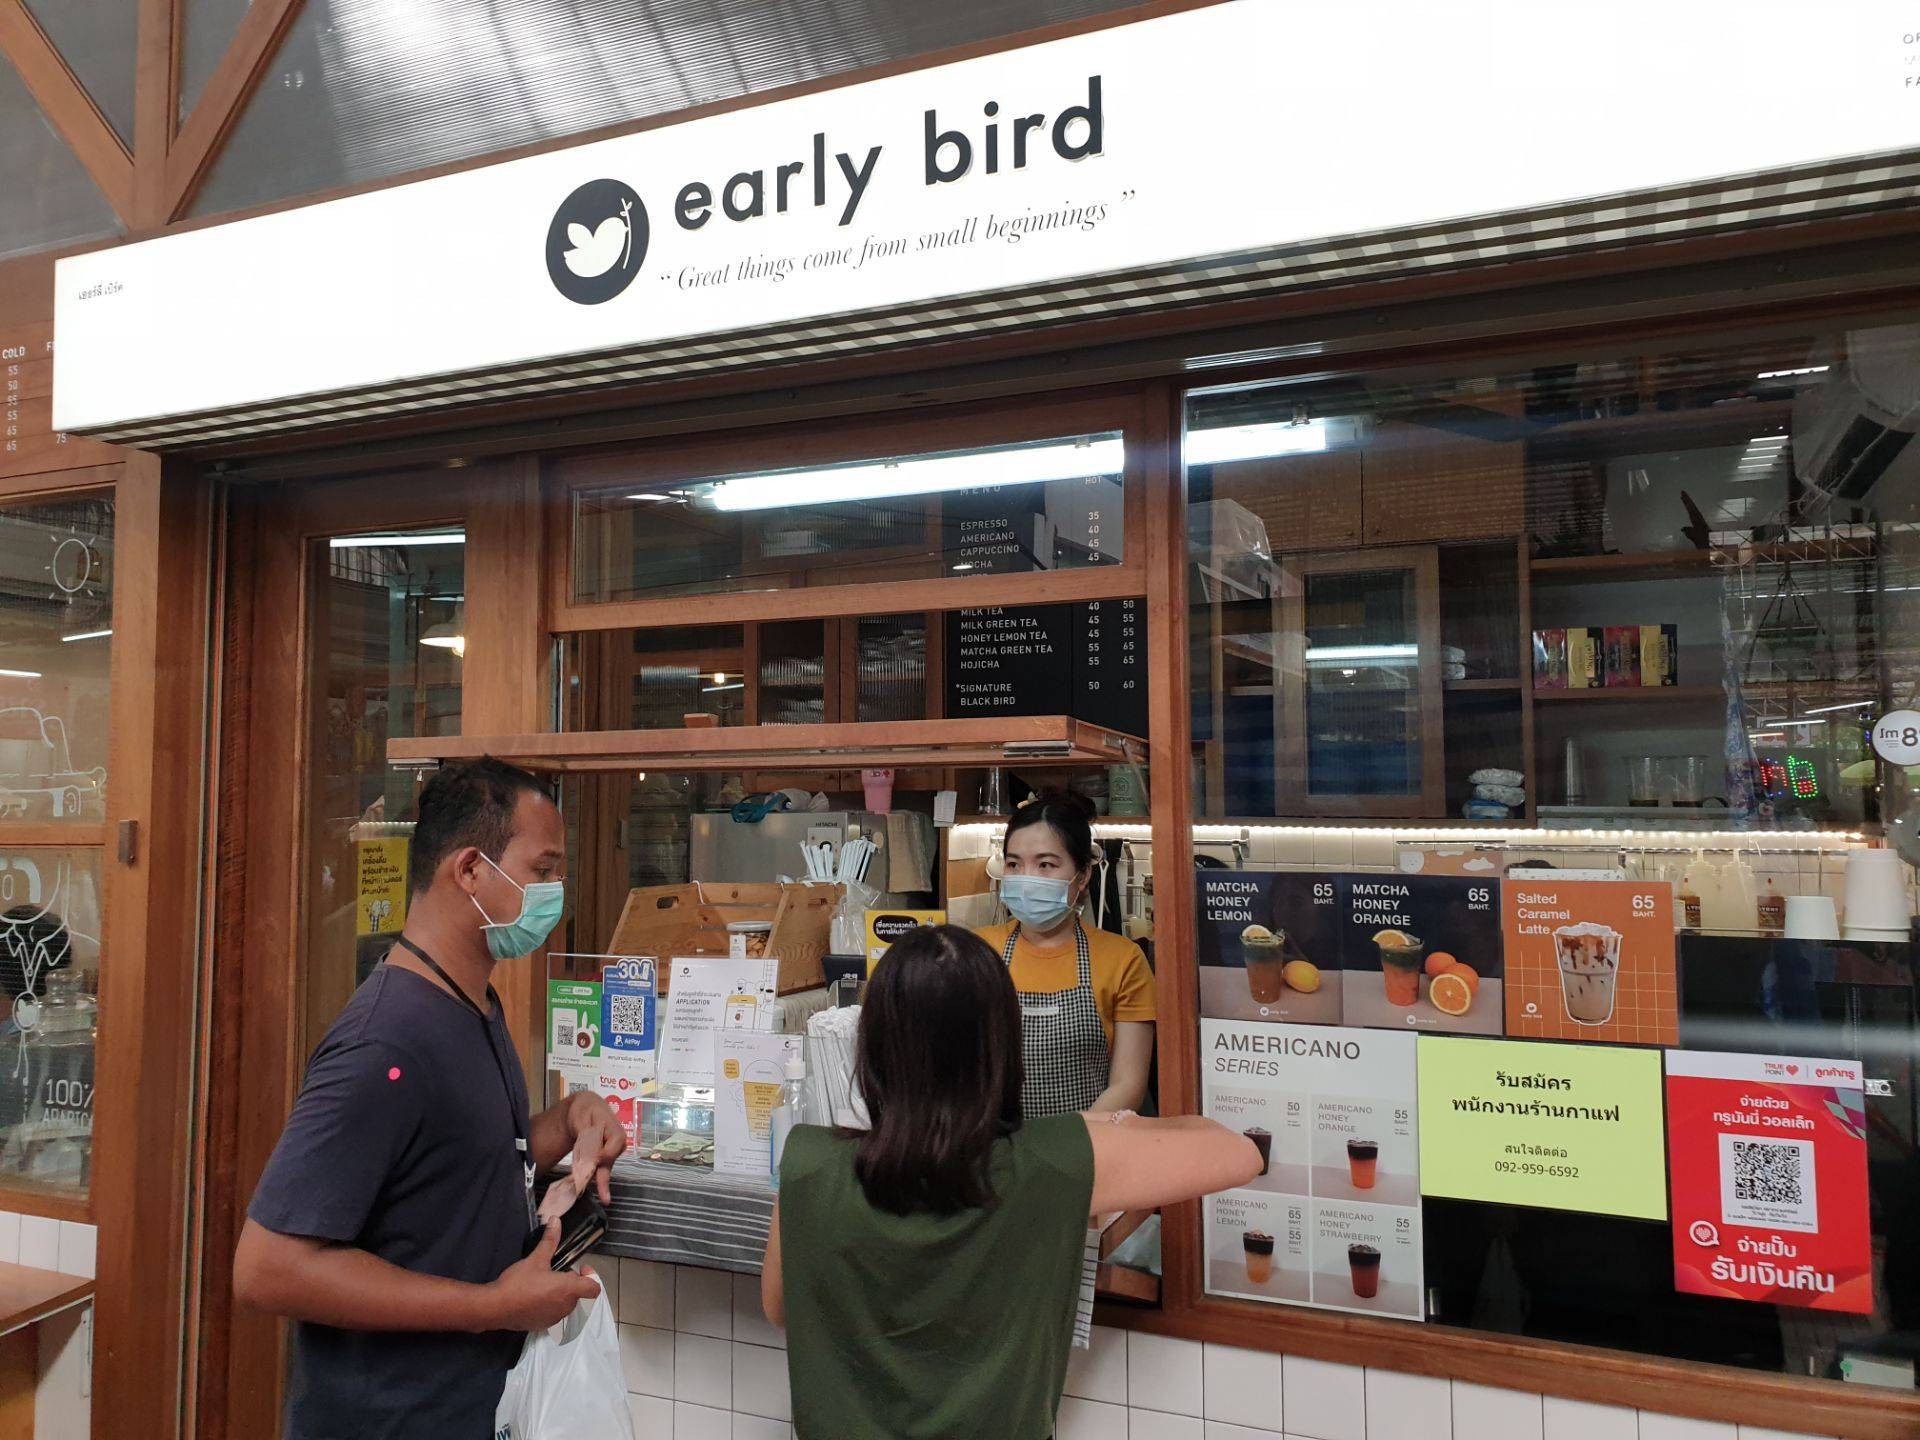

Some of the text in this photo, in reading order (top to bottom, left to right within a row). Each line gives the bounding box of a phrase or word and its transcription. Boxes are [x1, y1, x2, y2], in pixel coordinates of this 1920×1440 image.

[675, 75, 1103, 230] early bird
[738, 254, 796, 283] things
[803, 247, 853, 271] come
[852, 235, 907, 270] from
[916, 217, 978, 252] small
[985, 201, 1109, 244] beginnings
[2, 347, 25, 359] COLD
[1089, 512, 1099, 520] 35
[961, 519, 1008, 530] ESPRESSO
[1089, 526, 1099, 534] 40
[961, 532, 1014, 543] AMERICANO
[1089, 539, 1099, 547] 45
[961, 545, 1019, 557] CAPPUCCINO
[1089, 553, 1099, 561] 45
[1089, 602, 1099, 611] 40
[1123, 601, 1134, 609] 50
[961, 607, 1003, 616] MILK TEA
[1089, 616, 1099, 625] 45
[1123, 614, 1134, 622] 55
[961, 619, 1037, 630] MILK GREEN TEA
[961, 631, 1047, 642] HONEY LEMON TEA
[1089, 629, 1099, 638] 45
[1123, 628, 1134, 636] 55
[961, 645, 1053, 656] MATCHA GREEN TEA
[1089, 643, 1099, 652] 55
[1123, 642, 1134, 650] 65
[961, 660, 999, 669] HOJICHA
[1089, 657, 1099, 665] 55
[1123, 656, 1134, 664] 65
[1089, 682, 1099, 690] 50
[1123, 680, 1134, 689] 60
[961, 696, 1016, 706] BLACK BIRD
[1206, 882, 1259, 893] MATCHA
[1314, 883, 1333, 897] 65
[1353, 884, 1409, 896] MATCHA
[1468, 888, 1489, 902] 65
[1517, 893, 1557, 904] Salted
[1207, 896, 1250, 907] HONEY
[1353, 899, 1399, 910] HONEY
[1633, 895, 1654, 910] 65
[1208, 911, 1252, 921] LEMON
[1353, 913, 1411, 926] ORANGE
[1518, 908, 1570, 920] Caramel
[1519, 923, 1550, 935] Latte
[1215, 1033, 1360, 1060] AMERICANO
[1215, 1057, 1279, 1076] SERIES
[600, 1075, 616, 1085] true
[1496, 1070, 1571, 1091] รับสมัคร
[1215, 1095, 1266, 1106] AMERICANO
[1741, 1094, 1789, 1110] จ่ายด้วย
[1215, 1105, 1244, 1114] HONEY
[1287, 1102, 1300, 1111] 50
[1319, 1103, 1373, 1114] AMERICANO
[1452, 1096, 1620, 1122] พนักงานร้านกาแฟ
[1319, 1113, 1349, 1122] HONEY
[1395, 1109, 1408, 1119] 55
[1319, 1123, 1356, 1133] ORANGE
[1505, 1143, 1568, 1158] สนใจติดต่อ
[1495, 1161, 1580, 1178] 092-959-6592
[1217, 1198, 1268, 1210] AMERICANO
[1217, 1208, 1246, 1217] HONEY
[1289, 1210, 1301, 1219] 65
[1320, 1209, 1374, 1222] AMERICANO
[1217, 1218, 1247, 1227] LEMON
[1320, 1220, 1351, 1229] HONEY
[1396, 1218, 1410, 1228] 55
[1289, 1230, 1301, 1240] 55
[1320, 1229, 1382, 1243] STRAWBERRY
[1711, 1255, 1835, 1293] รับเงินคืน
